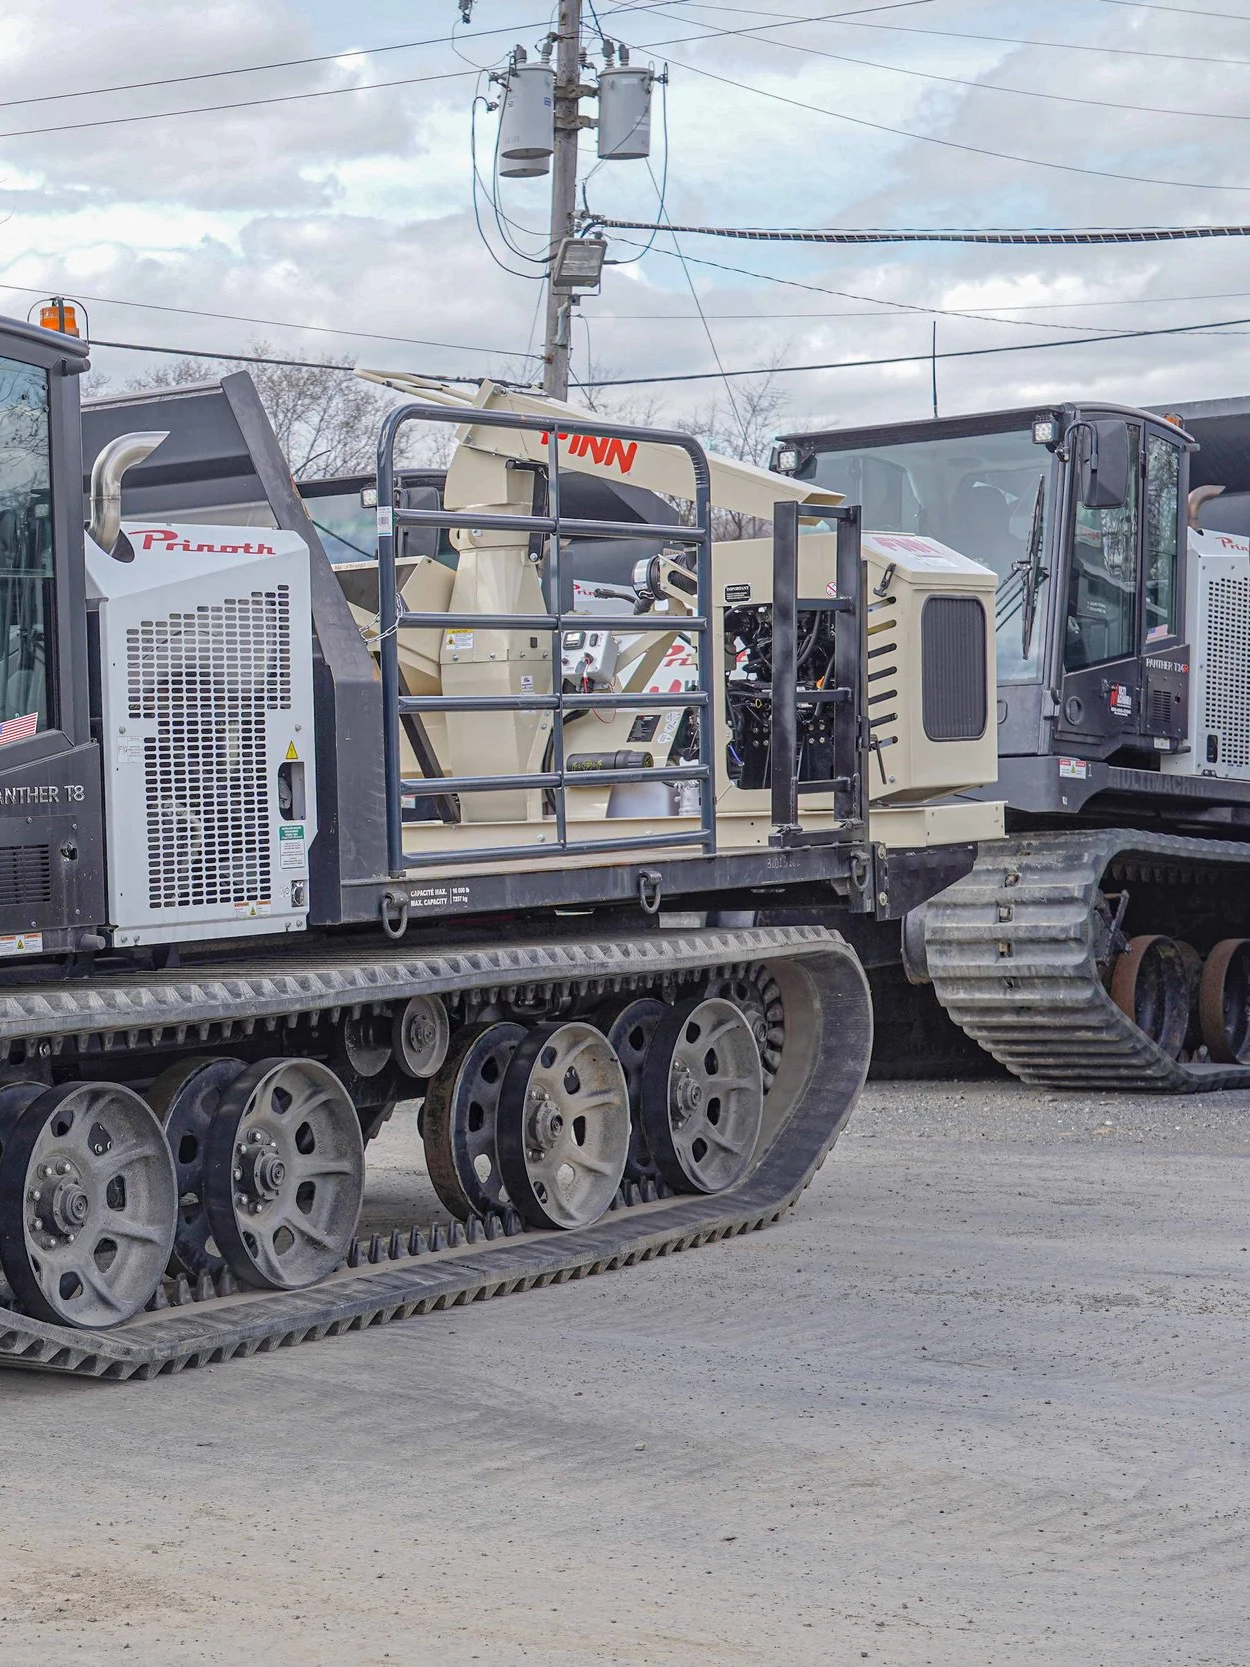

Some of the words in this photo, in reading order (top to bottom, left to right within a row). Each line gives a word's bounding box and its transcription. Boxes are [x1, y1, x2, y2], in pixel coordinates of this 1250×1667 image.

[128, 530, 276, 555] Prinoth
[64, 785, 85, 801] T8
[435, 888, 447, 896] MAX.
[411, 899, 423, 907] MAX.
